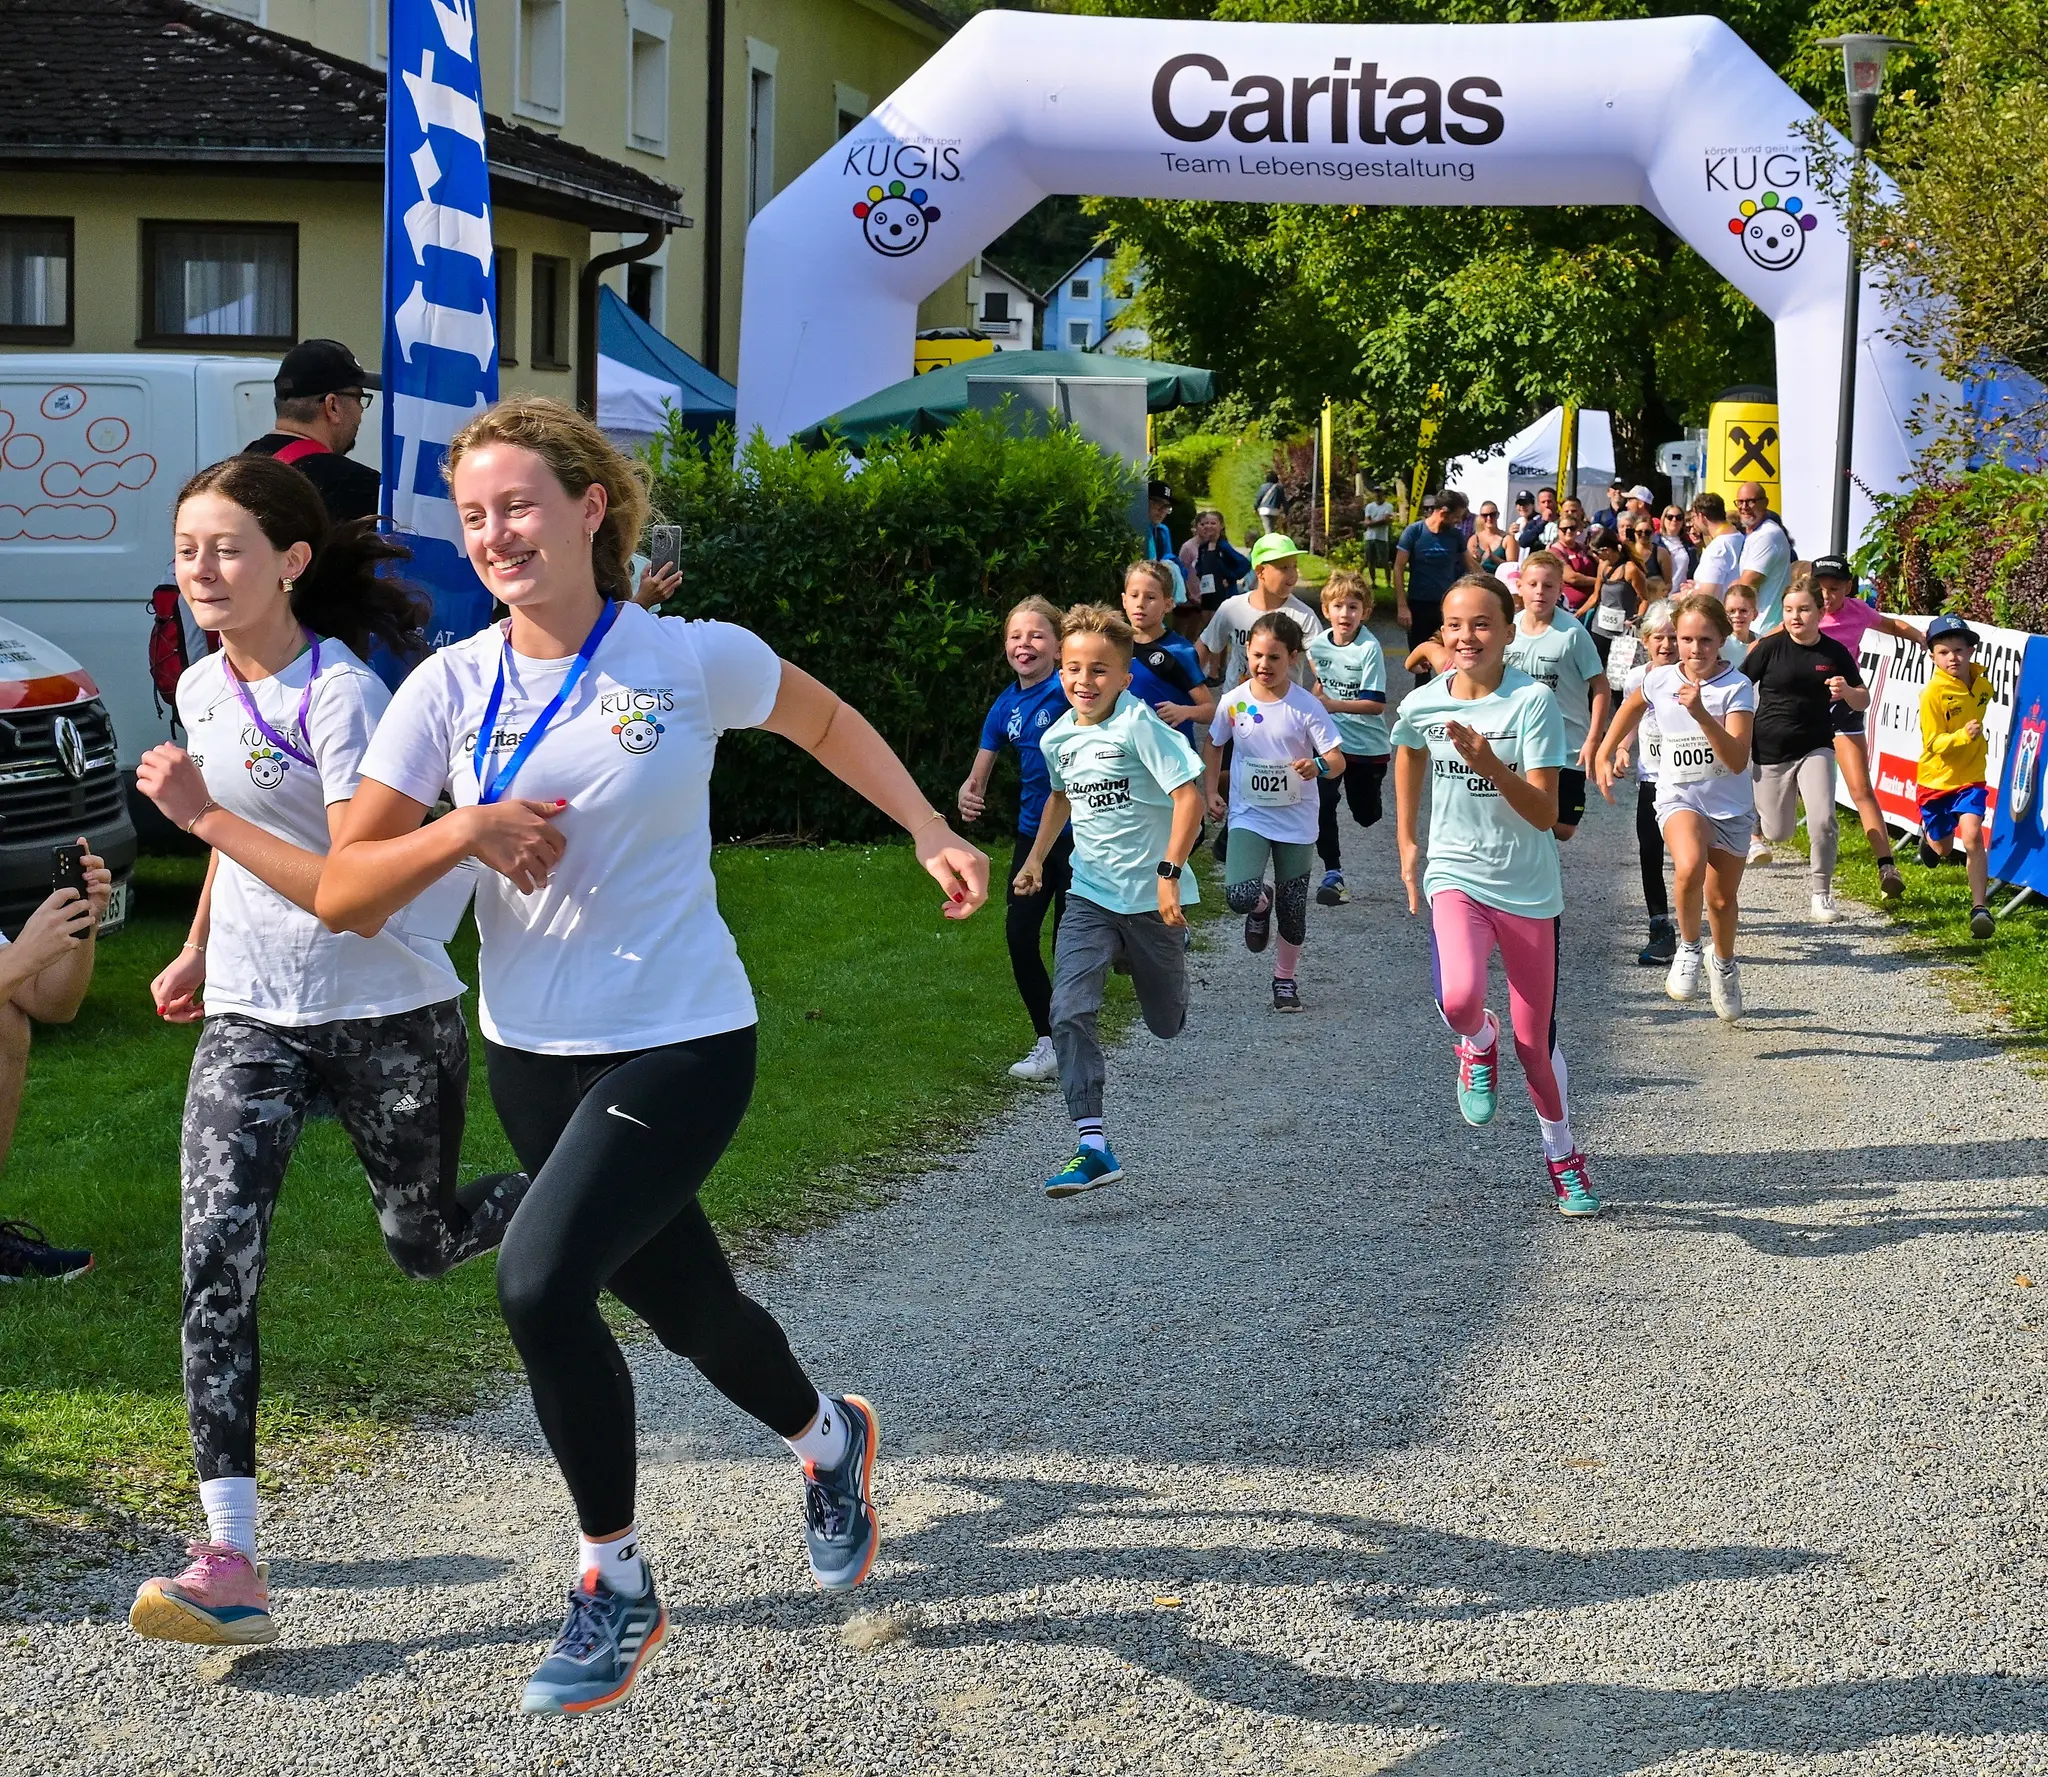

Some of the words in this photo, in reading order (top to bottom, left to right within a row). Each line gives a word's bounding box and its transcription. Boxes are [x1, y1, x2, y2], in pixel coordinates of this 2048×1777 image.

[1152, 53, 1504, 146] Caritas
[1160, 152, 1230, 173] Team
[1239, 155, 1475, 181] Lebensgestaltung
[1509, 463, 1548, 477] Caritas
[601, 693, 674, 715] KUGIS
[1674, 748, 1714, 767] 0005
[1251, 775, 1288, 792] 0021
[1088, 790, 1130, 808] CREW
[393, 1102, 421, 1111] adidas
